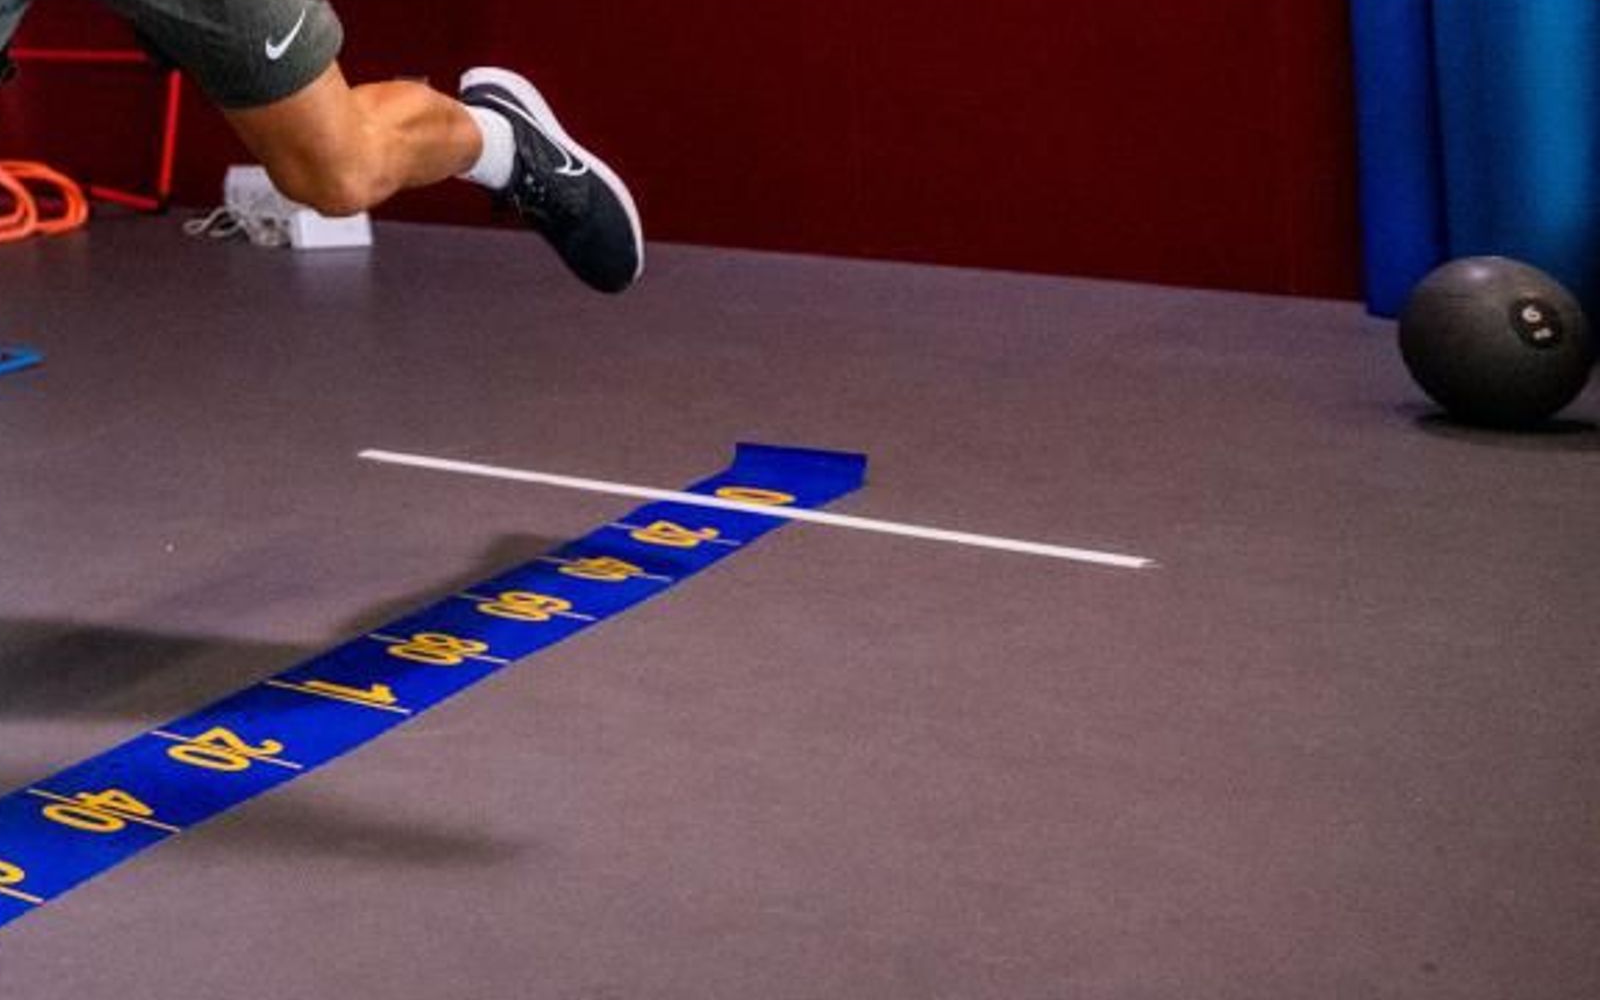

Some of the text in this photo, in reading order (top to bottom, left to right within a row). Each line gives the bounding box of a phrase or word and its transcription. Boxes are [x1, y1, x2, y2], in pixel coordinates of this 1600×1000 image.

[715, 487, 796, 507] 0
[631, 520, 720, 547] 20
[558, 556, 643, 582] 40
[477, 591, 572, 621] 60
[387, 633, 488, 665] 80
[302, 680, 398, 706] 1
[167, 727, 282, 771] 20
[42, 788, 155, 832] 40
